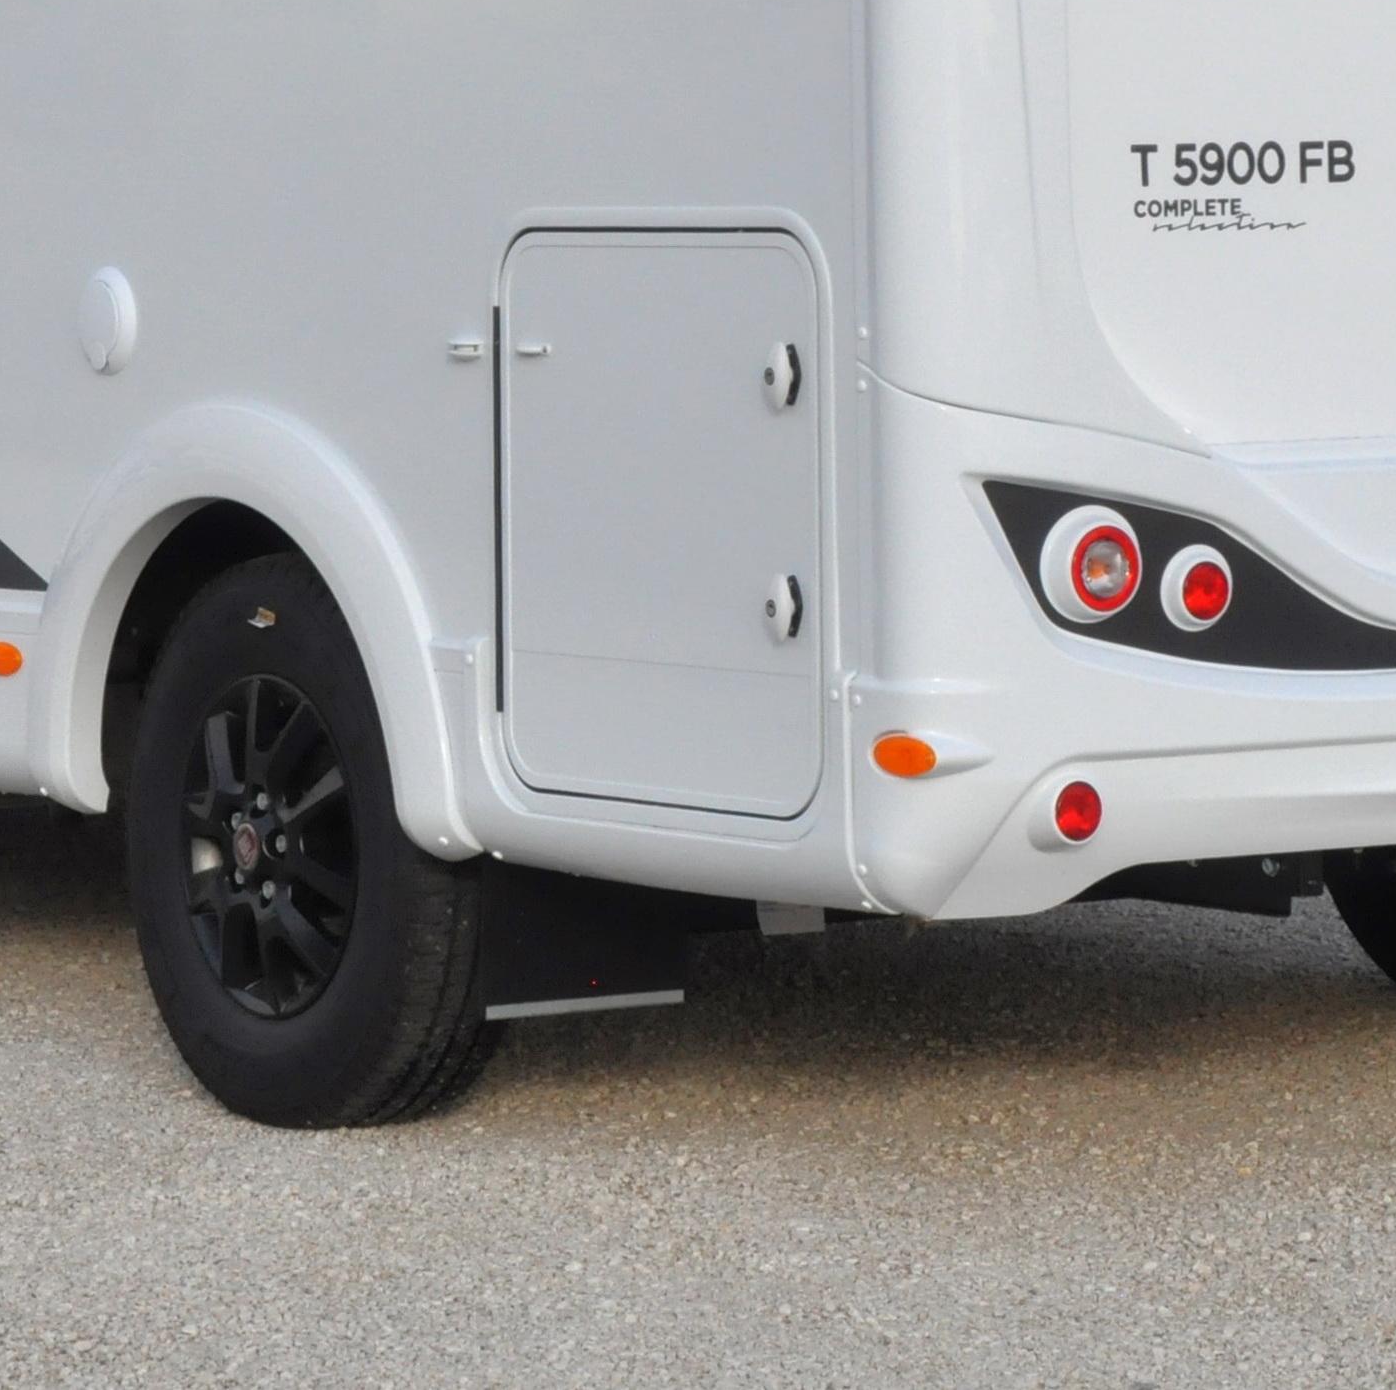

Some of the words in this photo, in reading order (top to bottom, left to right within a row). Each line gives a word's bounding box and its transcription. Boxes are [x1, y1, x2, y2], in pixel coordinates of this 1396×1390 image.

[1130, 144, 1158, 187] T
[1173, 140, 1286, 186] 5900
[1299, 140, 1356, 184] FB
[1133, 198, 1242, 218] COMPLETE
